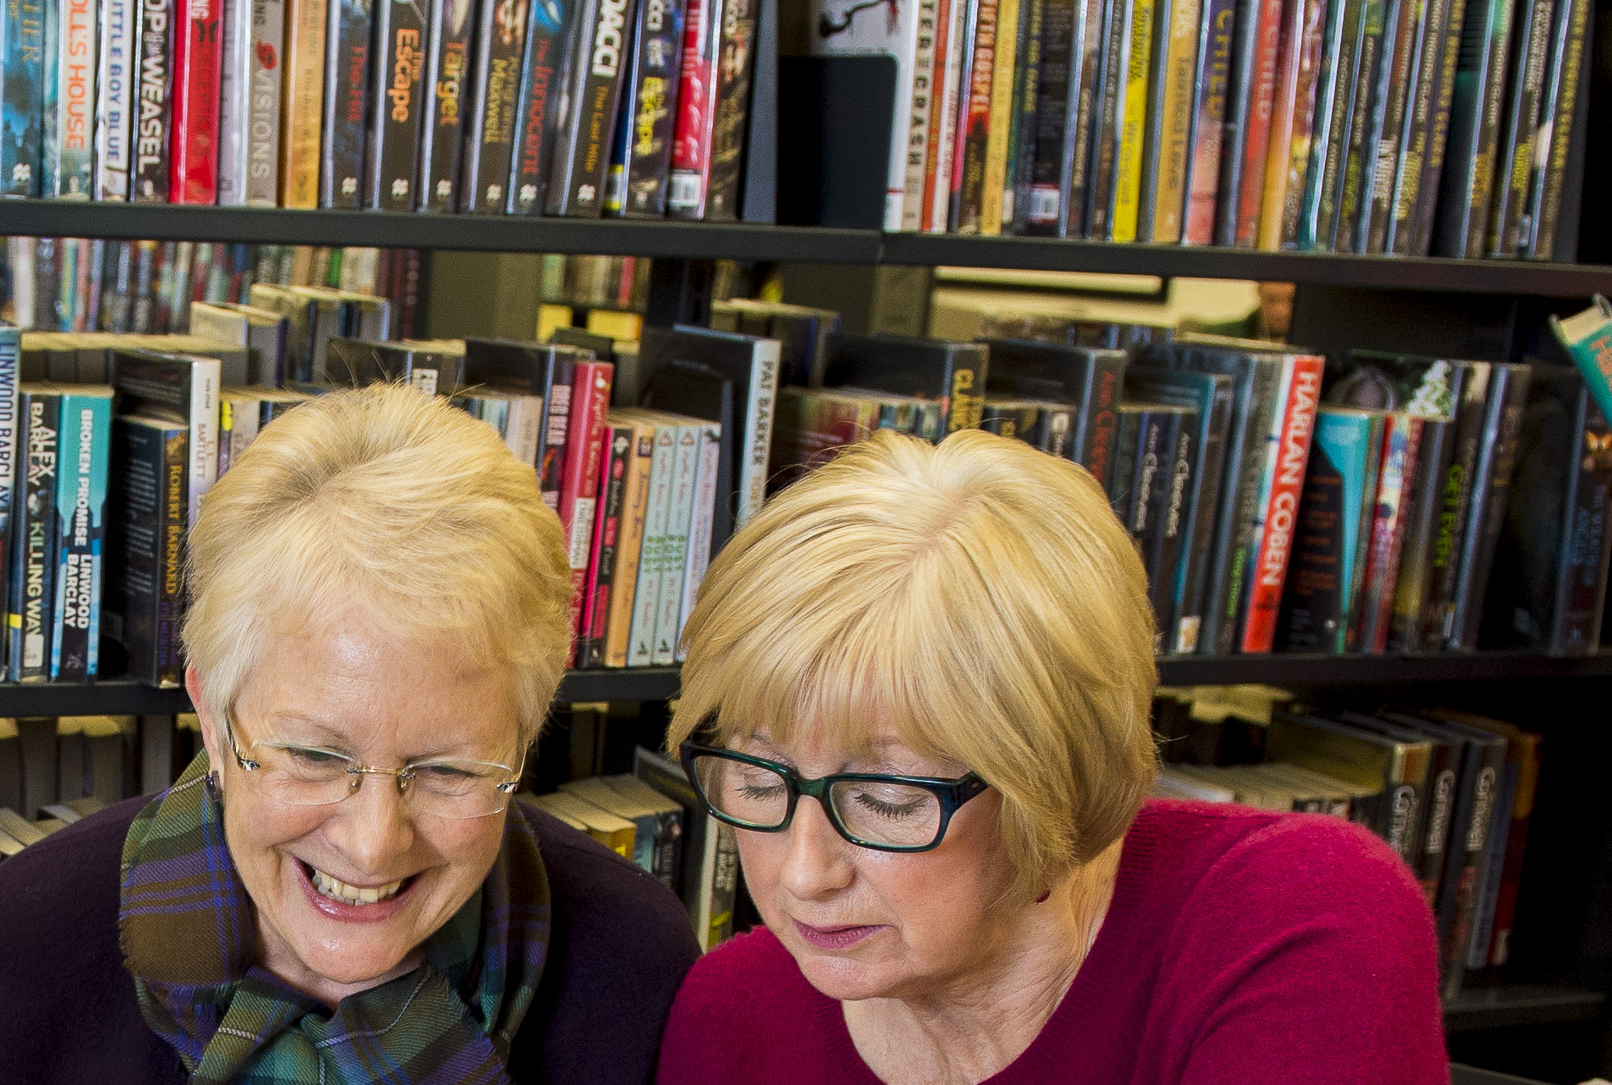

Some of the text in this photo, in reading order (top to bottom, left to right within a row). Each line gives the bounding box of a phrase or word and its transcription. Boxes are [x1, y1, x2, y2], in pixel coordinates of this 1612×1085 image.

[65, 64, 86, 151] HOUSE
[107, 0, 124, 161] ITTLE BOY BLUE
[387, 29, 420, 123] Escape
[436, 40, 468, 127] Target
[1207, 9, 1234, 119] CHILD
[1258, 26, 1278, 120] CHILD
[138, 55, 165, 175] WEASEL
[250, 69, 273, 179] VISIONS
[522, 66, 553, 176] Innocent
[27, 402, 45, 486] BARCLAY
[37, 426, 56, 478] ALEX
[195, 422, 207, 479] BARTLETT
[751, 360, 774, 465] PAT BARKER
[1279, 371, 1318, 485] HARLAN
[74, 408, 94, 547] BROKEN PROMISE
[168, 465, 182, 519] ROBERT
[1135, 453, 1159, 533] Cleeves
[1164, 460, 1190, 538] Cleeves
[26, 522, 45, 597] KILLING
[166, 525, 181, 595] BARNARD
[1262, 491, 1296, 587] COBEN
[64, 554, 79, 629] BARCLAY
[77, 553, 93, 629] LINWOOD
[1425, 767, 1455, 855] Cornwell
[1464, 765, 1496, 853] Cornwell
